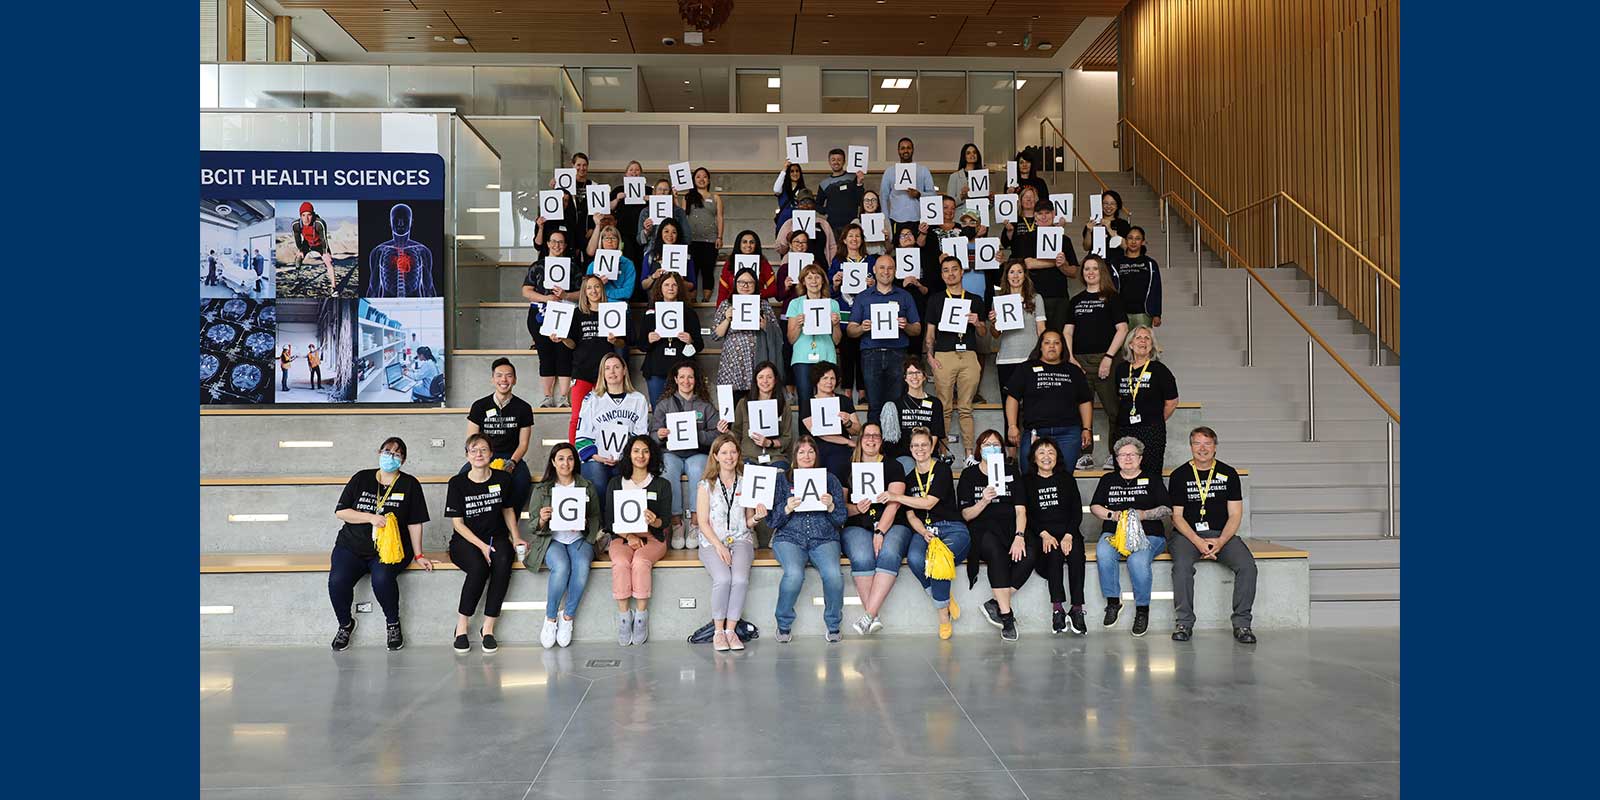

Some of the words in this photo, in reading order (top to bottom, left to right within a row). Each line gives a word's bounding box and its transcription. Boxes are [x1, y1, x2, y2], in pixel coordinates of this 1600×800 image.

[201, 168, 245, 185] BCIT
[252, 169, 328, 186] HEALTH
[334, 169, 430, 186] SCIENCES
[596, 409, 640, 424] VANCOUVER
[466, 506, 492, 515] EDUCATION
[558, 497, 578, 522] G
